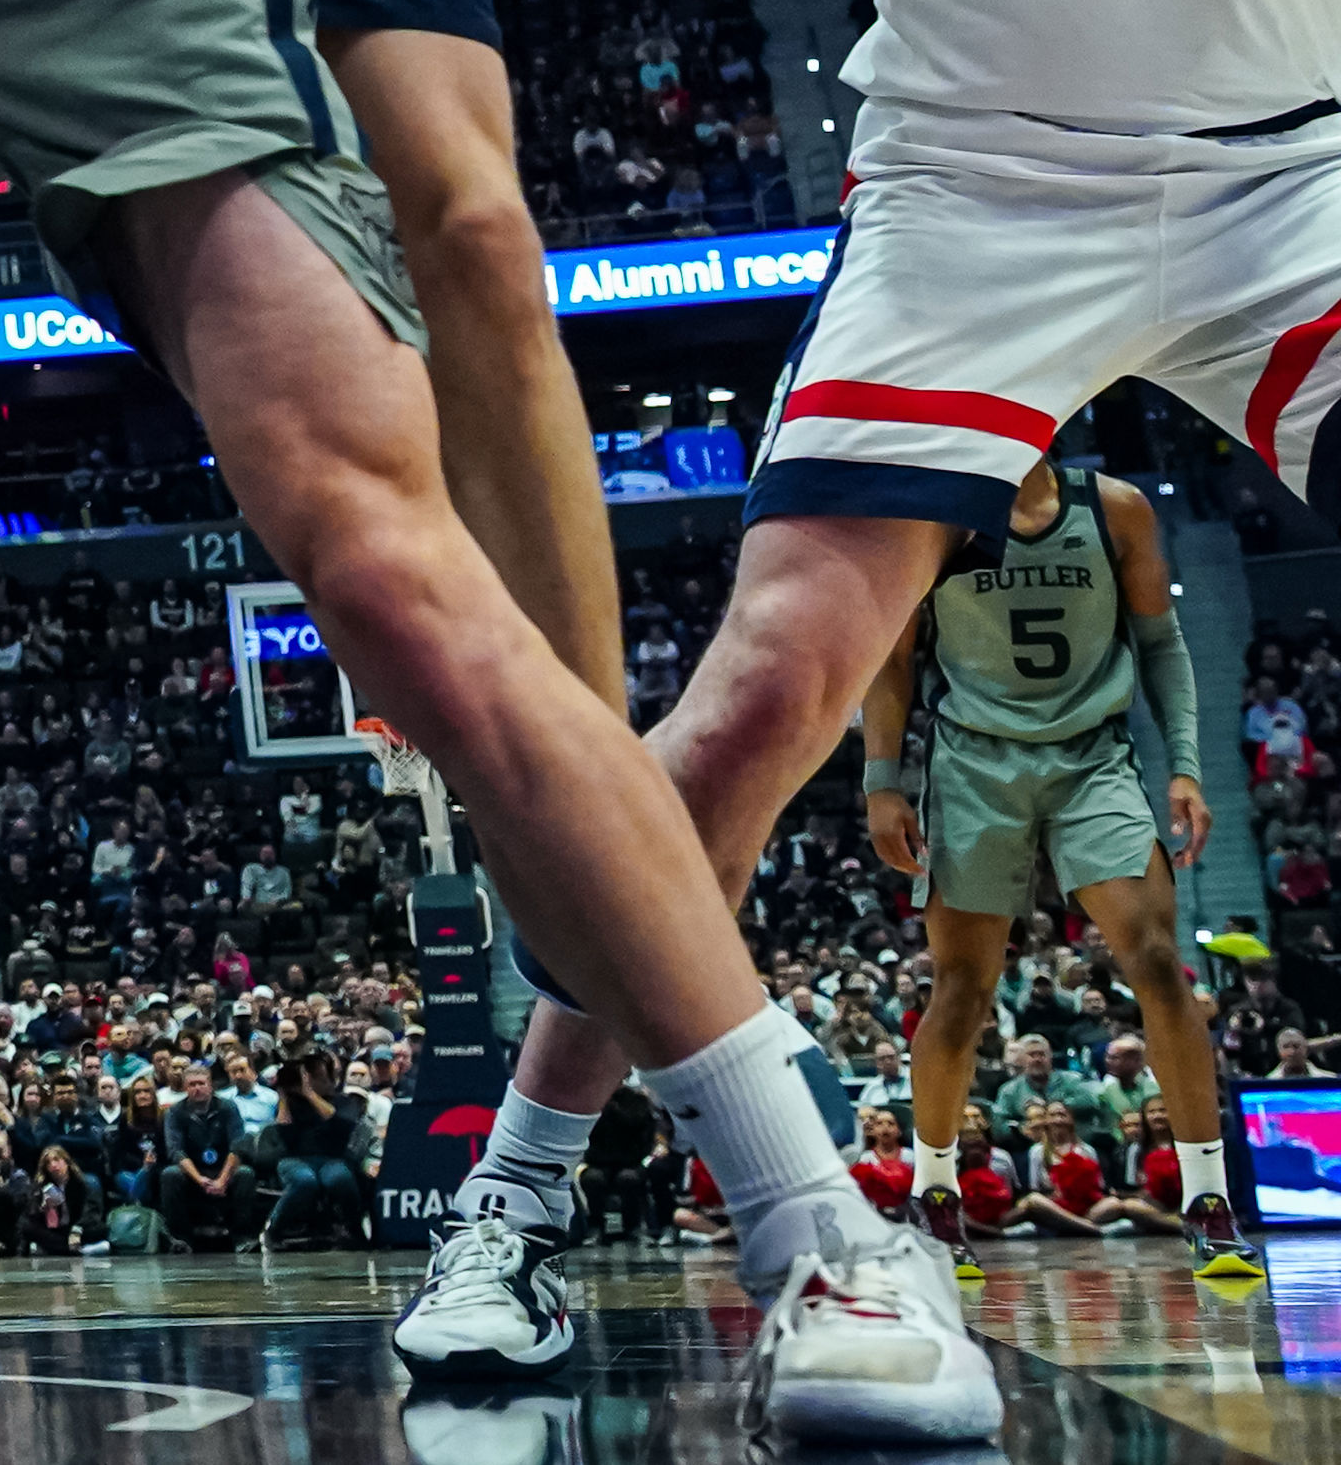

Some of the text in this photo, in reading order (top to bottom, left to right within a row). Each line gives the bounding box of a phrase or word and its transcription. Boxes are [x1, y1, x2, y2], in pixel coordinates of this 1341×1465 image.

[569, 250, 724, 304] Alumni
[181, 531, 245, 572] 121
[974, 565, 1095, 594] BUTLER
[1009, 607, 1071, 680] 5
[423, 945, 474, 956] TRAVELERS
[428, 992, 478, 1004] TRAVELERS
[433, 1045, 485, 1057] TRAVELERS
